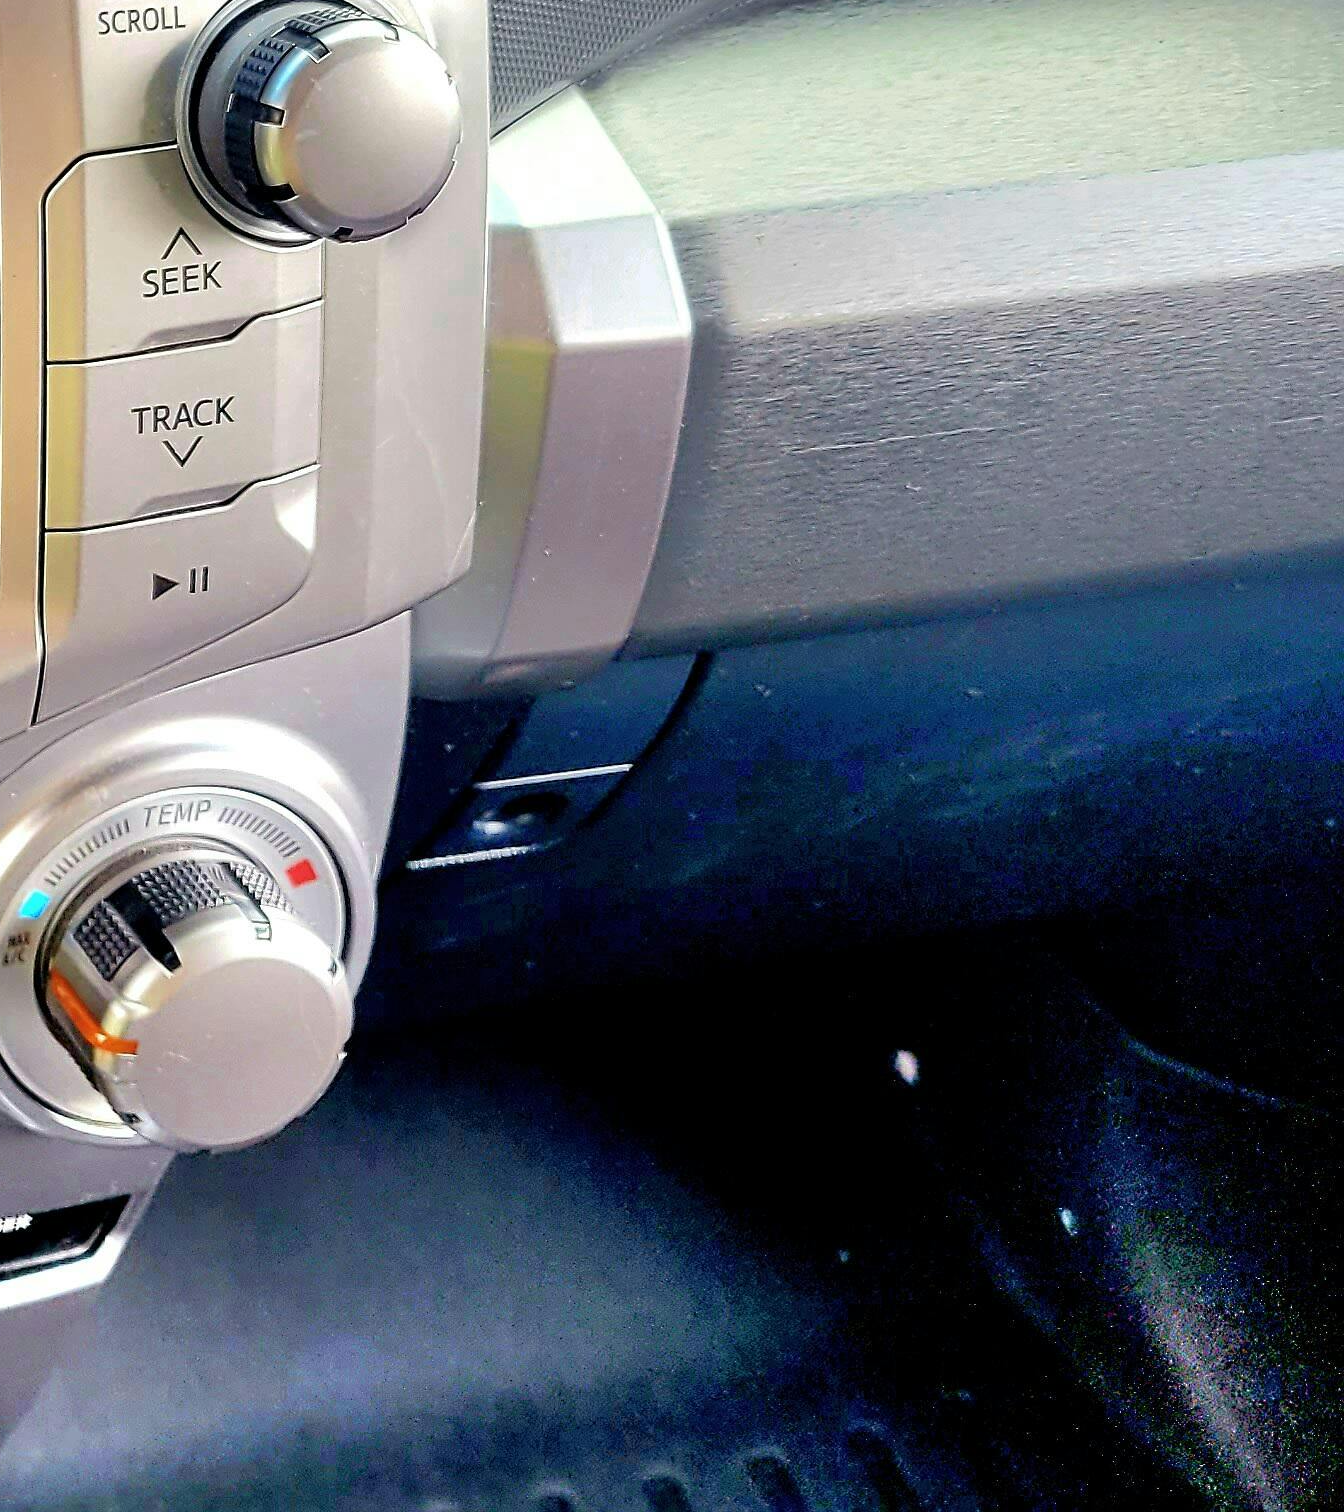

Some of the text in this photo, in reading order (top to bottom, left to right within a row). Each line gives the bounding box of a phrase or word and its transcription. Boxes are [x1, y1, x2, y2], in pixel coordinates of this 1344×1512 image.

[96, 4, 187, 35] SCROLL
[141, 259, 223, 299] SEEK
[130, 395, 236, 434] TRACK
[142, 798, 212, 829] TEMP
